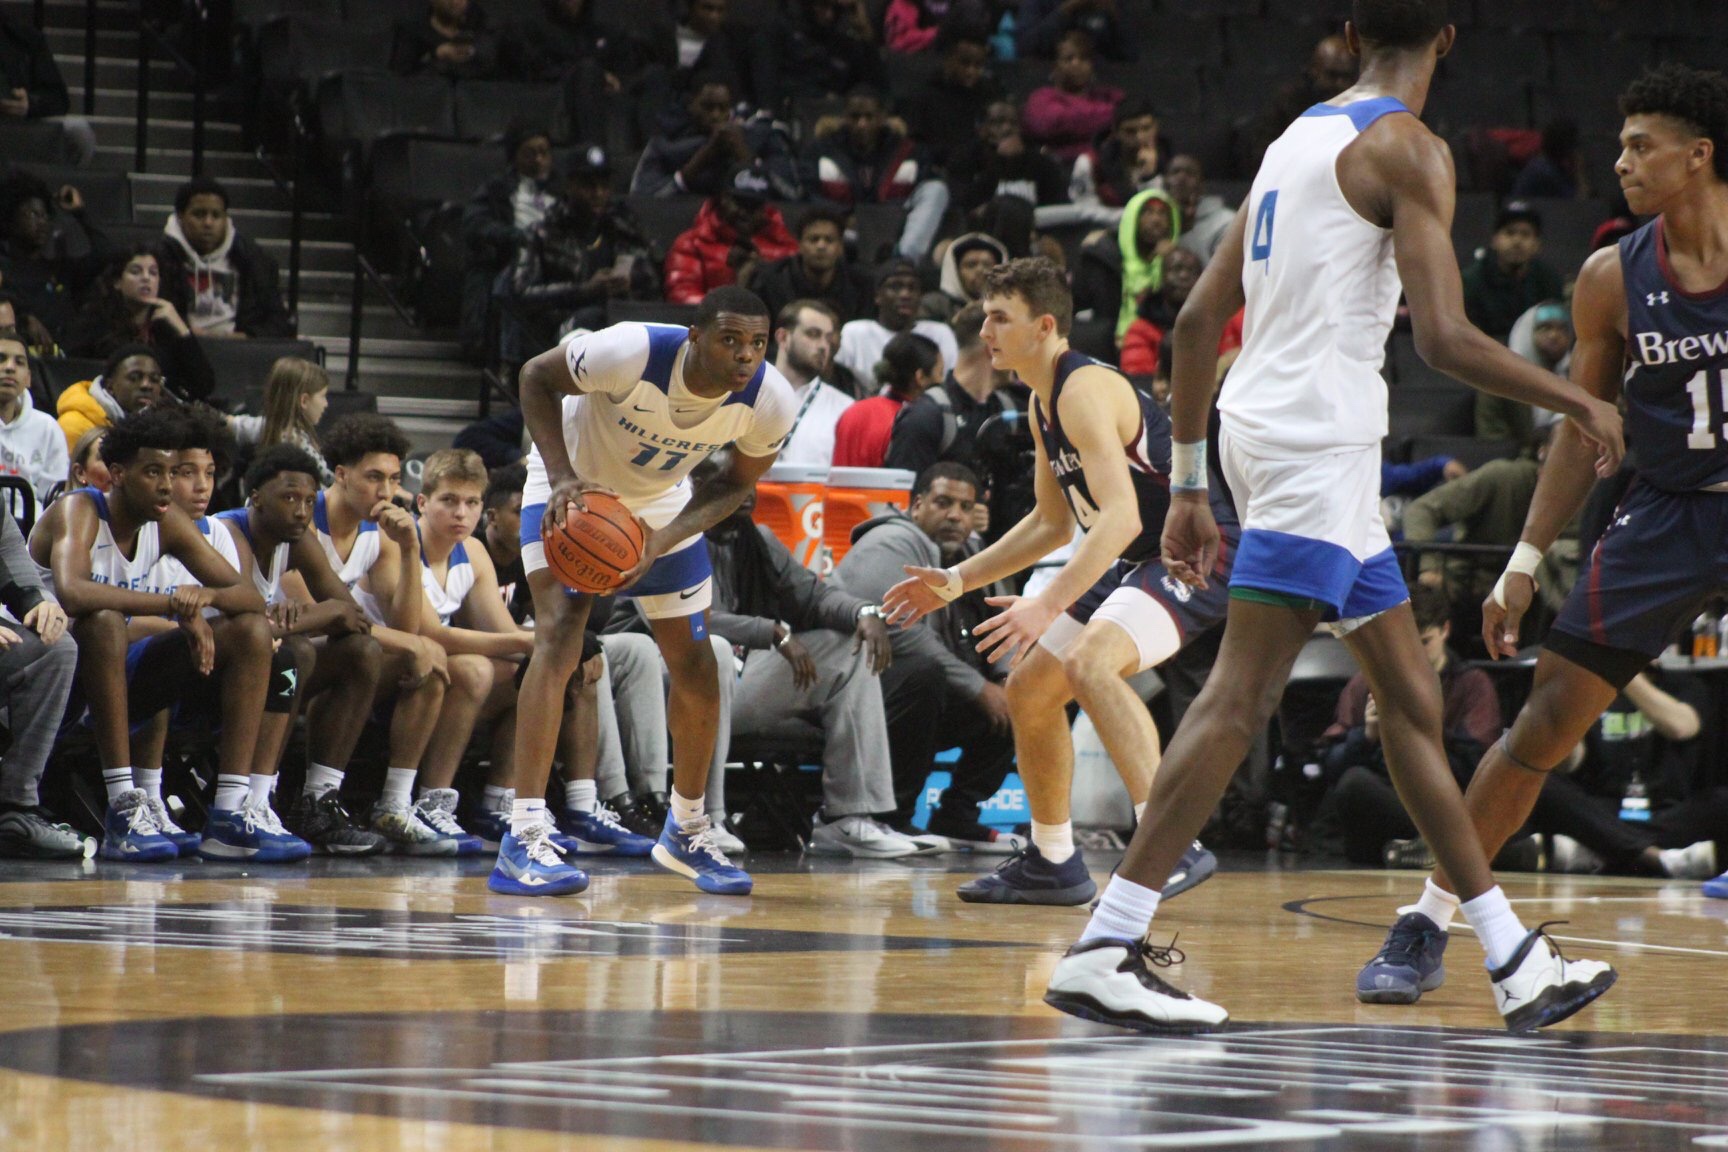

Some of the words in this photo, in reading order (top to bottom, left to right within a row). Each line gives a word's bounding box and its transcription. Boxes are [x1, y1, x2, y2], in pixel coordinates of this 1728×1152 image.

[1251, 188, 1279, 276] 4
[617, 416, 722, 452] HILLCRES
[558, 541, 612, 586] Wilson
